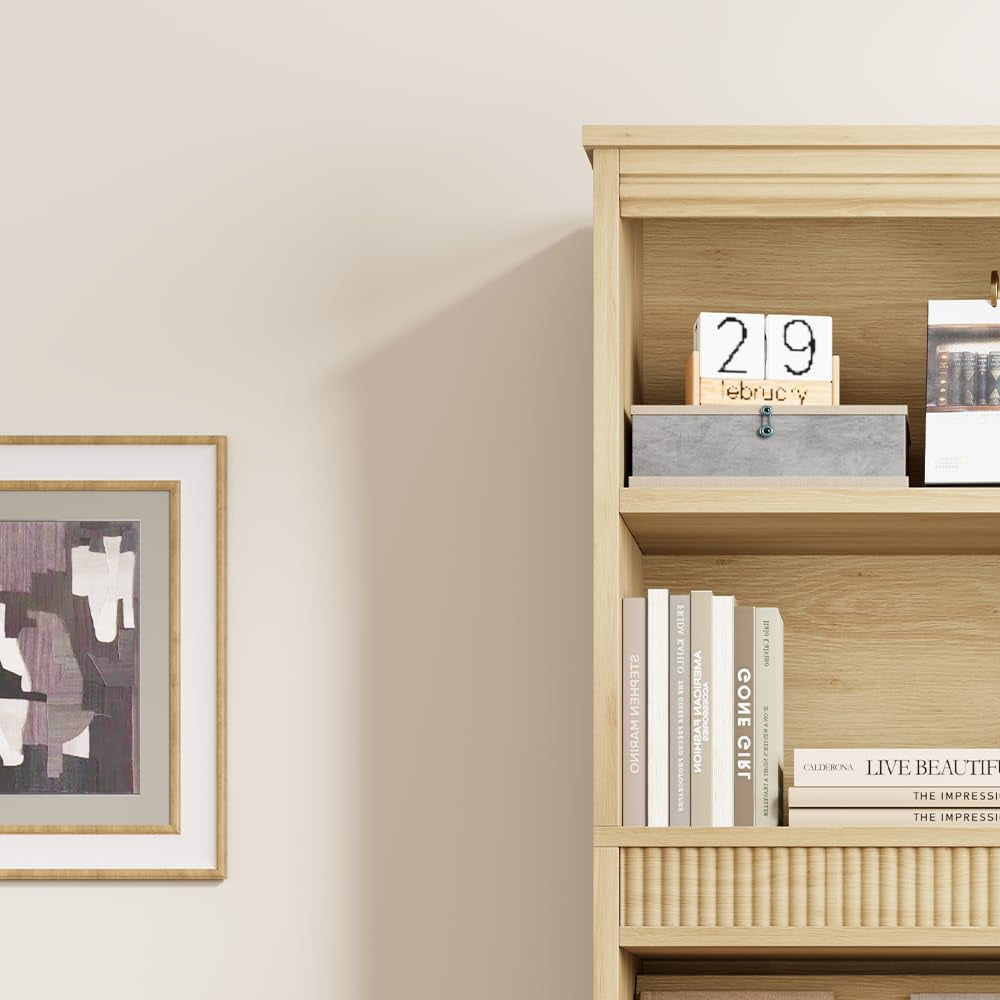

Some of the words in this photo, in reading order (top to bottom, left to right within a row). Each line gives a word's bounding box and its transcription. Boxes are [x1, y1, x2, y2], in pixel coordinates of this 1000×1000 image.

[804, 763, 853, 771] CALDERONA
[868, 760, 910, 775] LIVE
[914, 792, 935, 800] THE
[914, 813, 935, 821] THE
